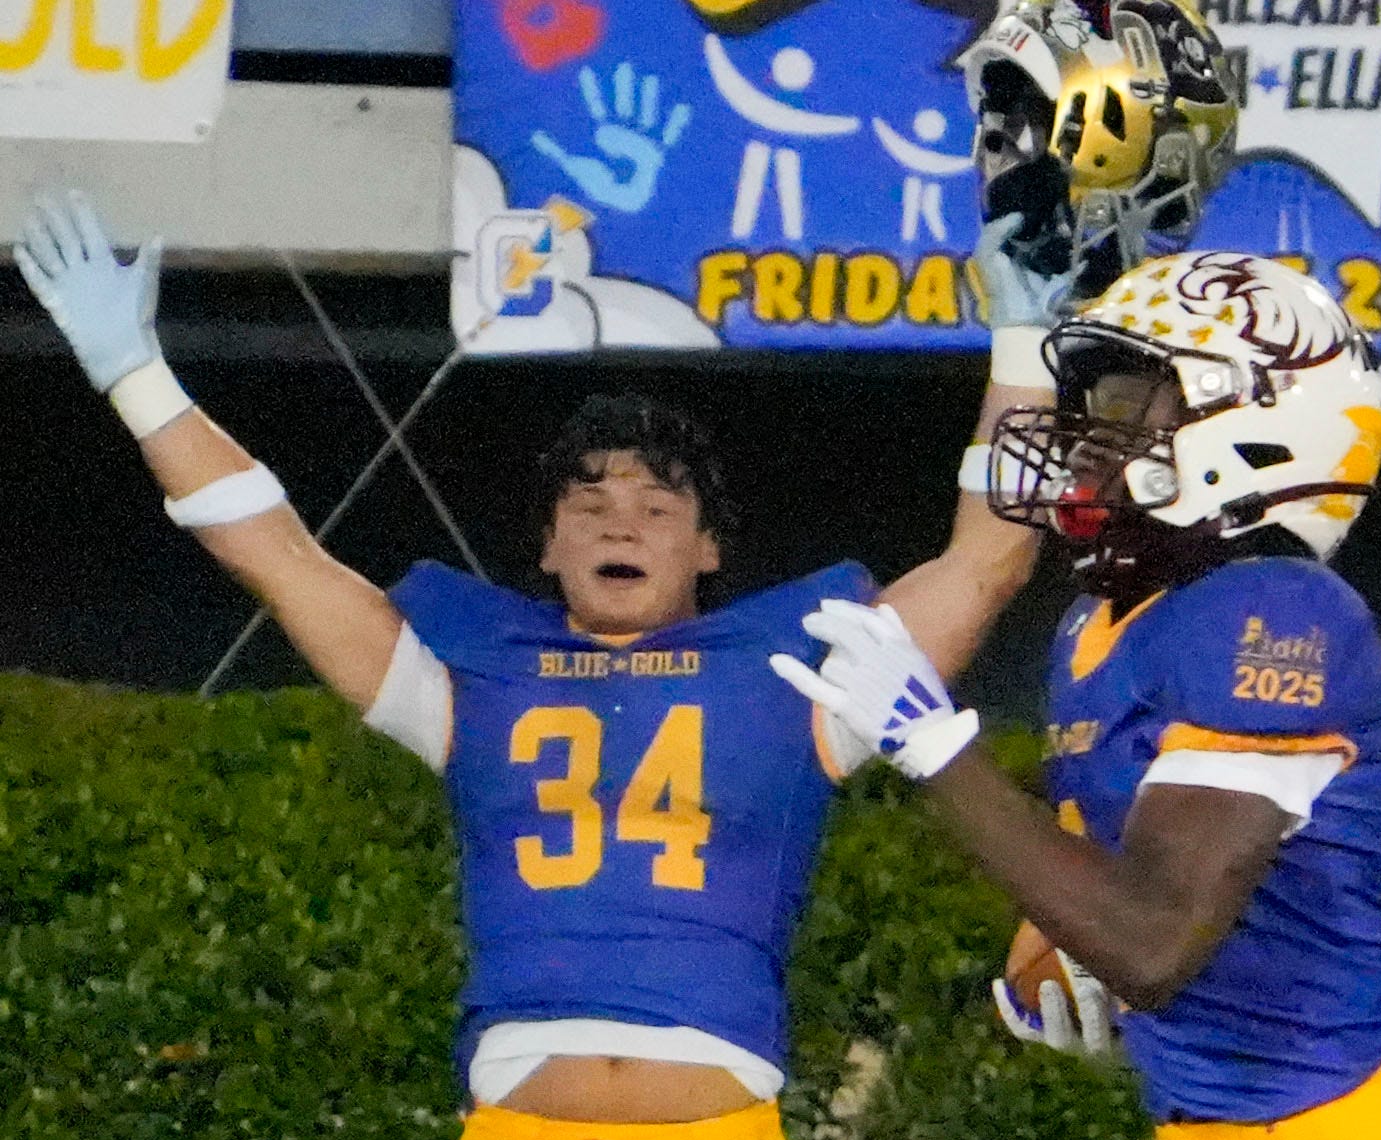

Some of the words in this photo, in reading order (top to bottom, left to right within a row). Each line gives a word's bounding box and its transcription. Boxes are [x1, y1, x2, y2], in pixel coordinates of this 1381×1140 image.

[538, 652, 610, 677] BLUE
[631, 651, 700, 677] GOLD
[1232, 663, 1326, 707] 2025
[510, 704, 712, 891] 34
